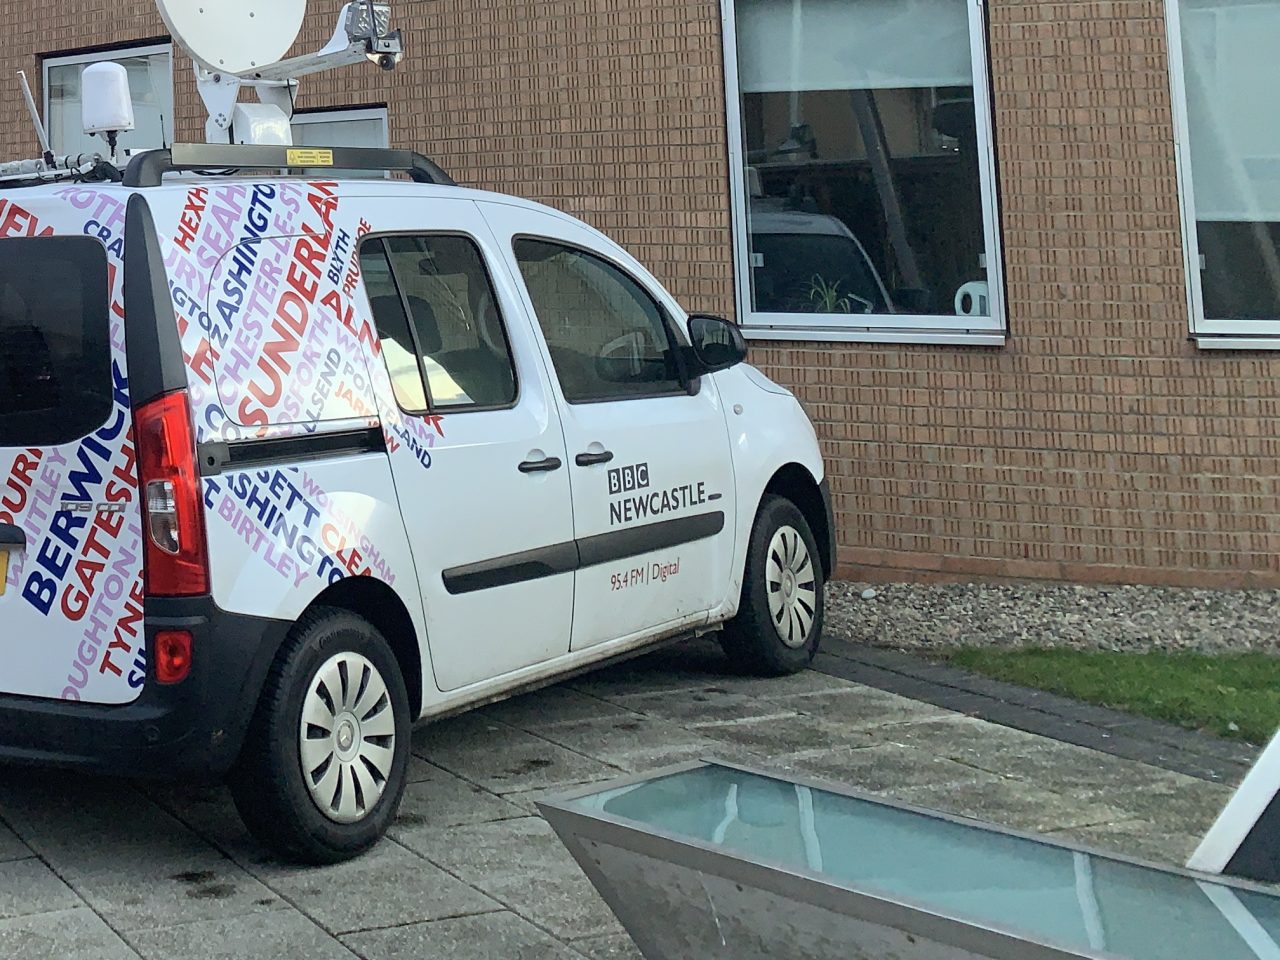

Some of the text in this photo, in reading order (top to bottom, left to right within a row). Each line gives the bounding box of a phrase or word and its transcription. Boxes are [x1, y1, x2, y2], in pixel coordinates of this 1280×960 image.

[174, 187, 209, 254] HEXH
[197, 185, 247, 281] SEAH
[216, 184, 276, 331] ASHINGTO
[327, 228, 350, 286] BLYTH
[238, 182, 339, 437] SUNDERLAN
[607, 462, 650, 495] BBC
[609, 482, 706, 526] NEWCASTLE
[218, 494, 310, 589] BIRTLEY
[610, 557, 680, 591] 95.4 FM Digital
